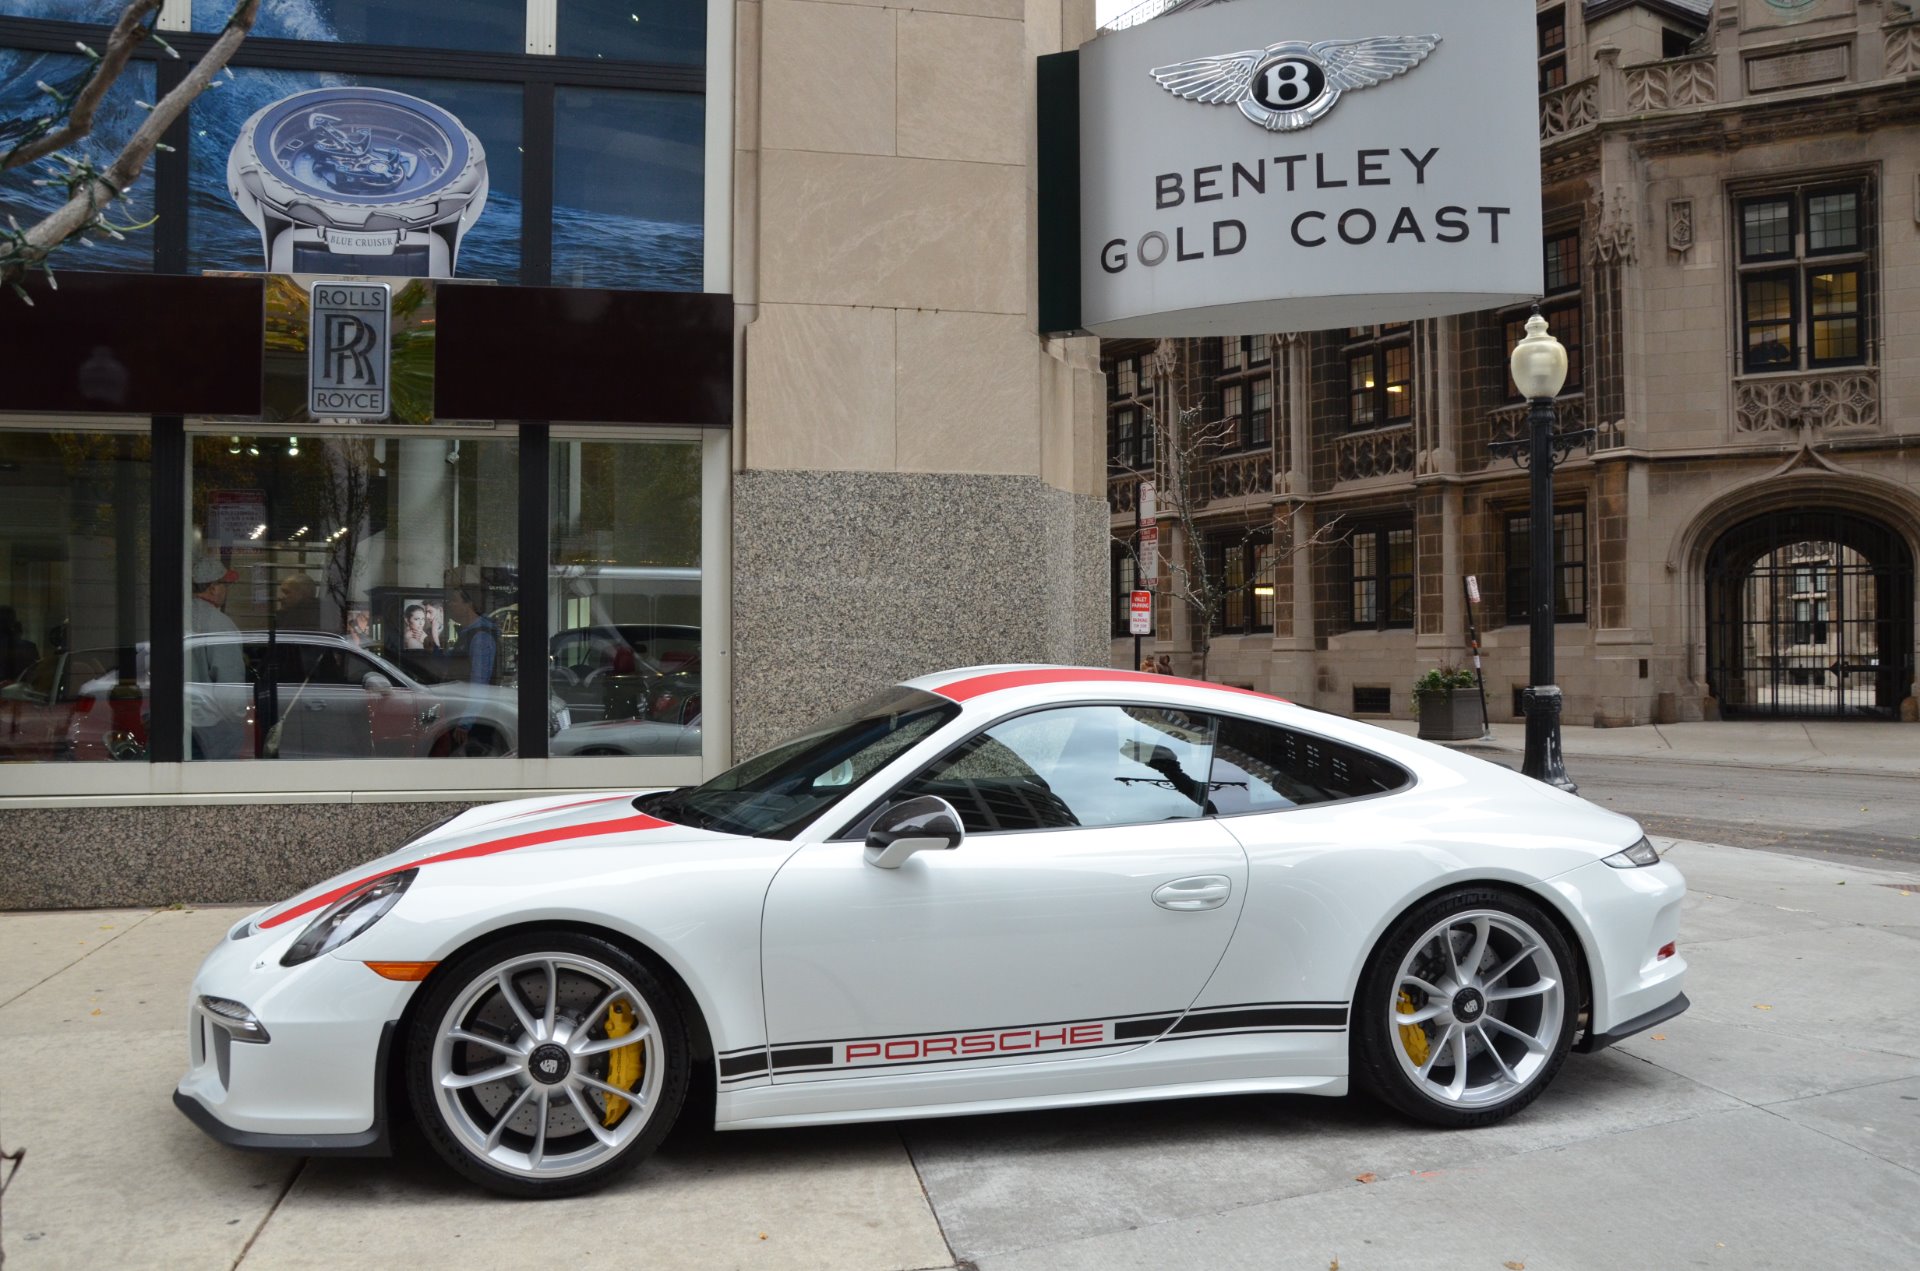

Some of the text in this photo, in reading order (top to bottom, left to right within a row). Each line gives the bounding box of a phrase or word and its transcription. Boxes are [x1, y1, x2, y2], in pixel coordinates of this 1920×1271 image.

[1266, 60, 1312, 106] B
[1155, 147, 1440, 210] BENTLEY
[331, 235, 393, 247] BLUE CRUISER
[1100, 206, 1511, 274] GOLD COAST
[319, 290, 381, 306] ROLLS
[317, 393, 379, 408] ROYCE
[846, 1024, 1103, 1062] PORSCHE
